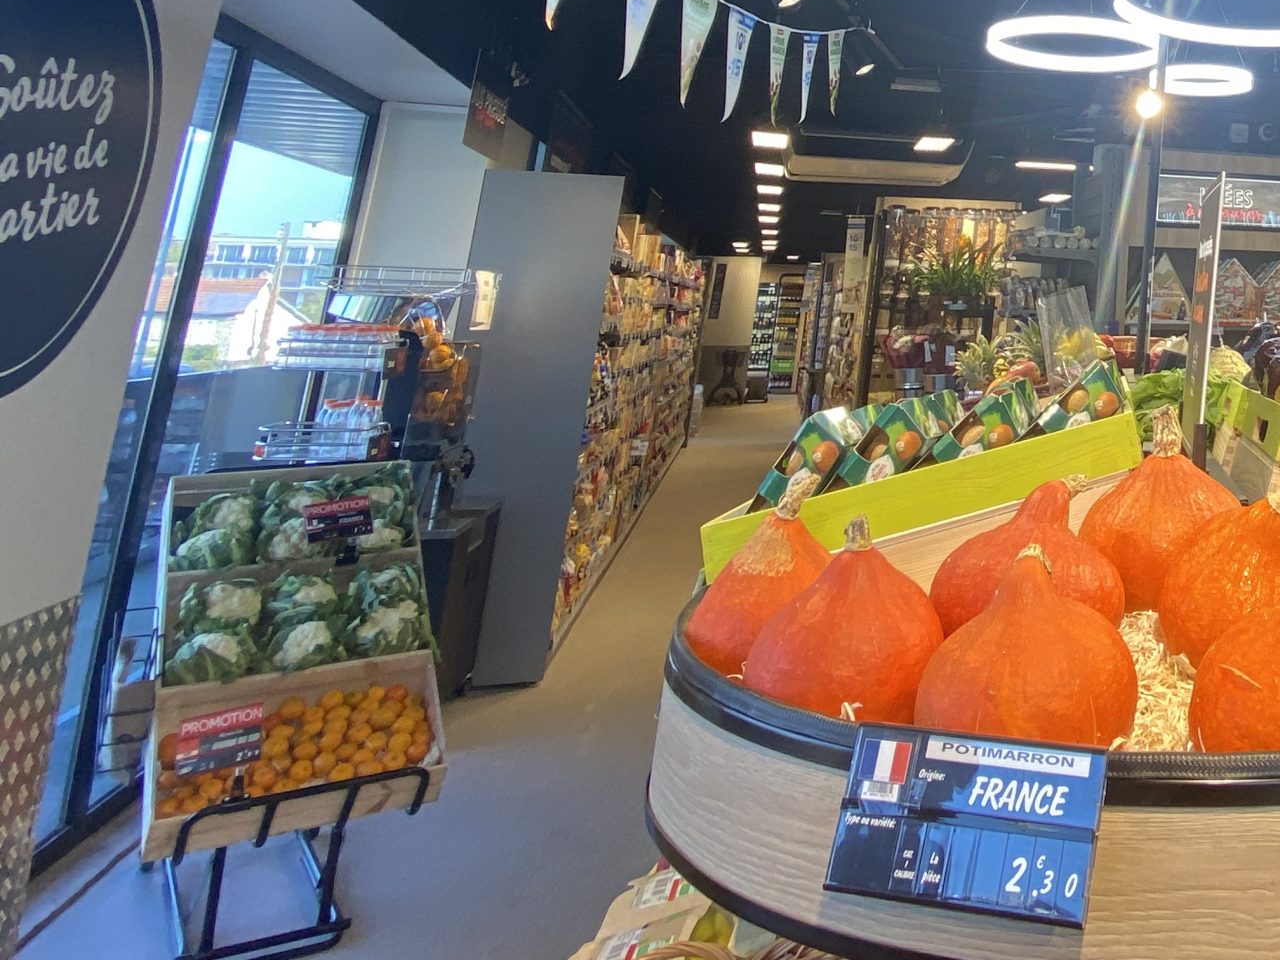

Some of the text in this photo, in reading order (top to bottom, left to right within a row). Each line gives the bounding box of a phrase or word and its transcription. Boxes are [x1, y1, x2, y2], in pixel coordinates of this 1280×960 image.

[27, 141, 67, 179] vie
[74, 127, 108, 170] de
[307, 499, 369, 516] PROMOTION
[182, 707, 263, 736] PROMOTION
[941, 742, 1075, 767] POTIMARRON
[918, 768, 1070, 817] Origine: FRANCE
[845, 812, 860, 826] Type
[929, 851, 939, 865] La
[921, 869, 941, 884] pièce
